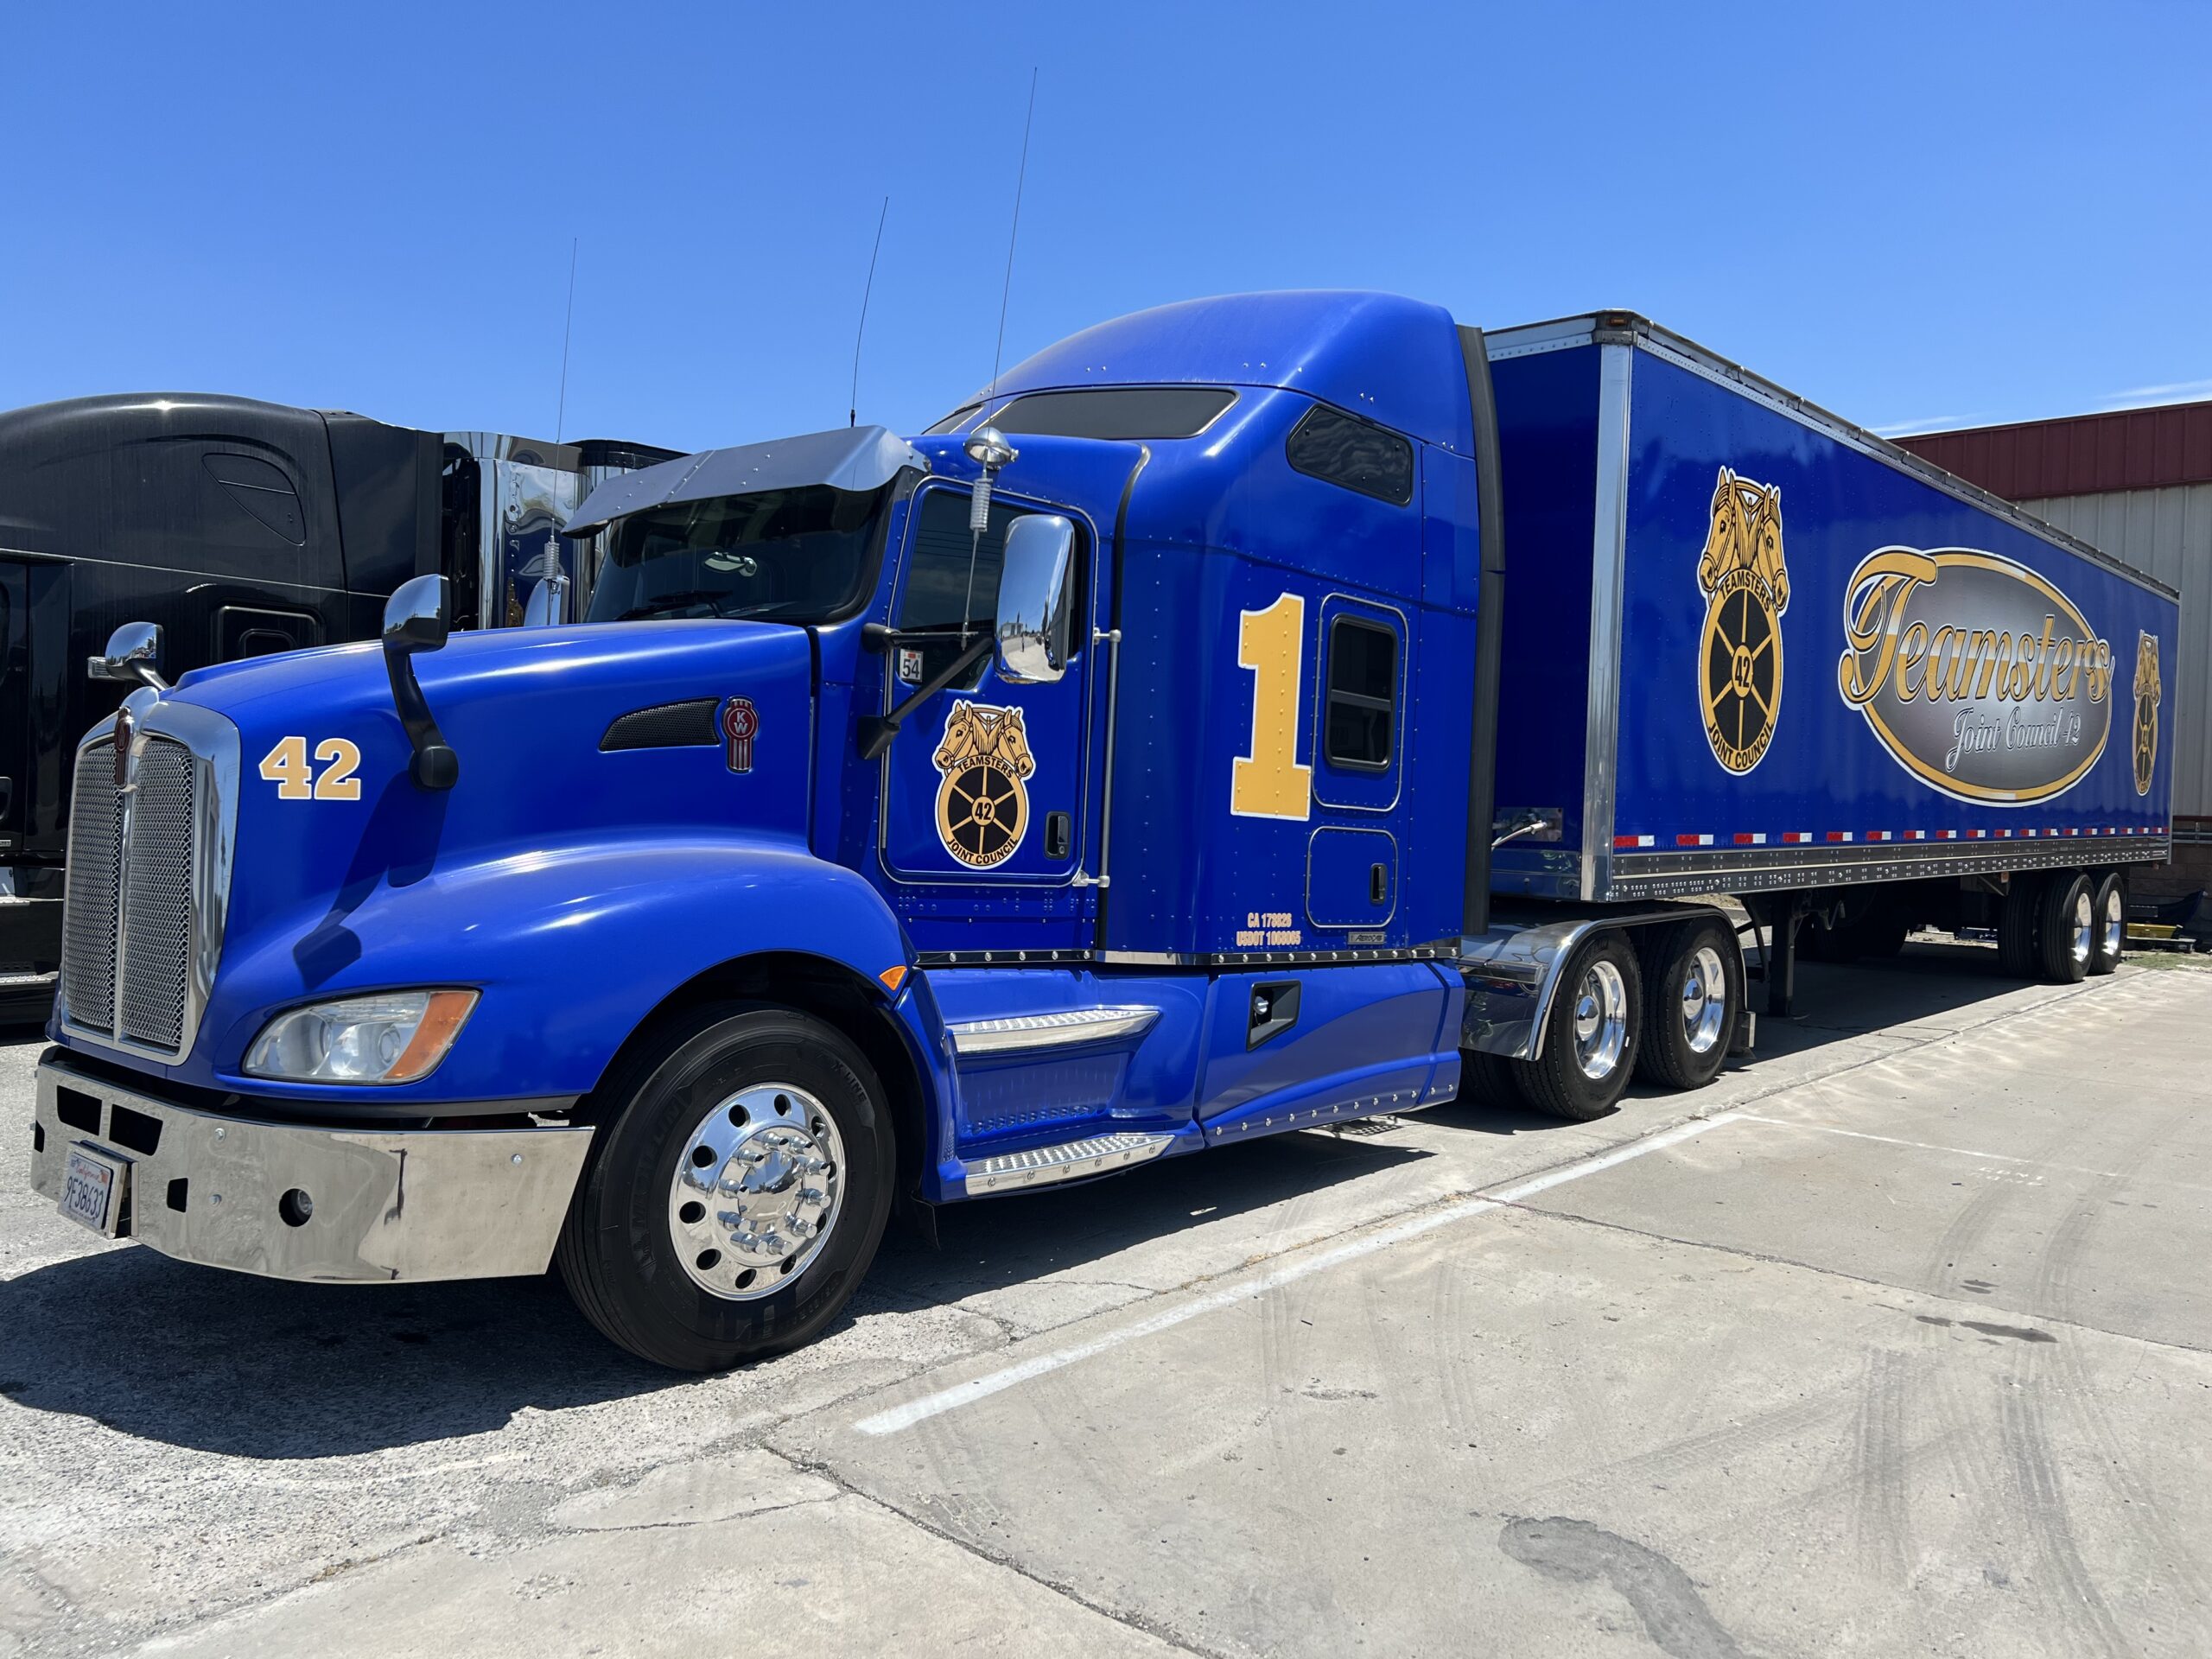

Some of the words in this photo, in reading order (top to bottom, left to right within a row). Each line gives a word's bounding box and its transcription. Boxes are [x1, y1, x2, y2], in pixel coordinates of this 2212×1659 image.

[1719, 570, 1771, 613] TEAMSTERS
[1839, 546, 2115, 710] Teamsters
[902, 658, 920, 678] 54
[1734, 655, 1751, 689] 42
[1230, 592, 1312, 821] 1
[1708, 721, 1734, 765] JOINT
[1734, 721, 1775, 768] COUNCIL
[1945, 706, 2002, 772] Joint
[2005, 705, 2064, 751] Council
[2063, 710, 2082, 747] 42
[258, 735, 361, 801] 42
[957, 756, 1014, 779] TEAMSTERS
[975, 802, 992, 821] 42
[947, 838, 975, 862] JOINT
[976, 837, 1018, 864] COUNCIL
[1247, 912, 1261, 928] CA
[1236, 931, 1265, 946] USDOT
